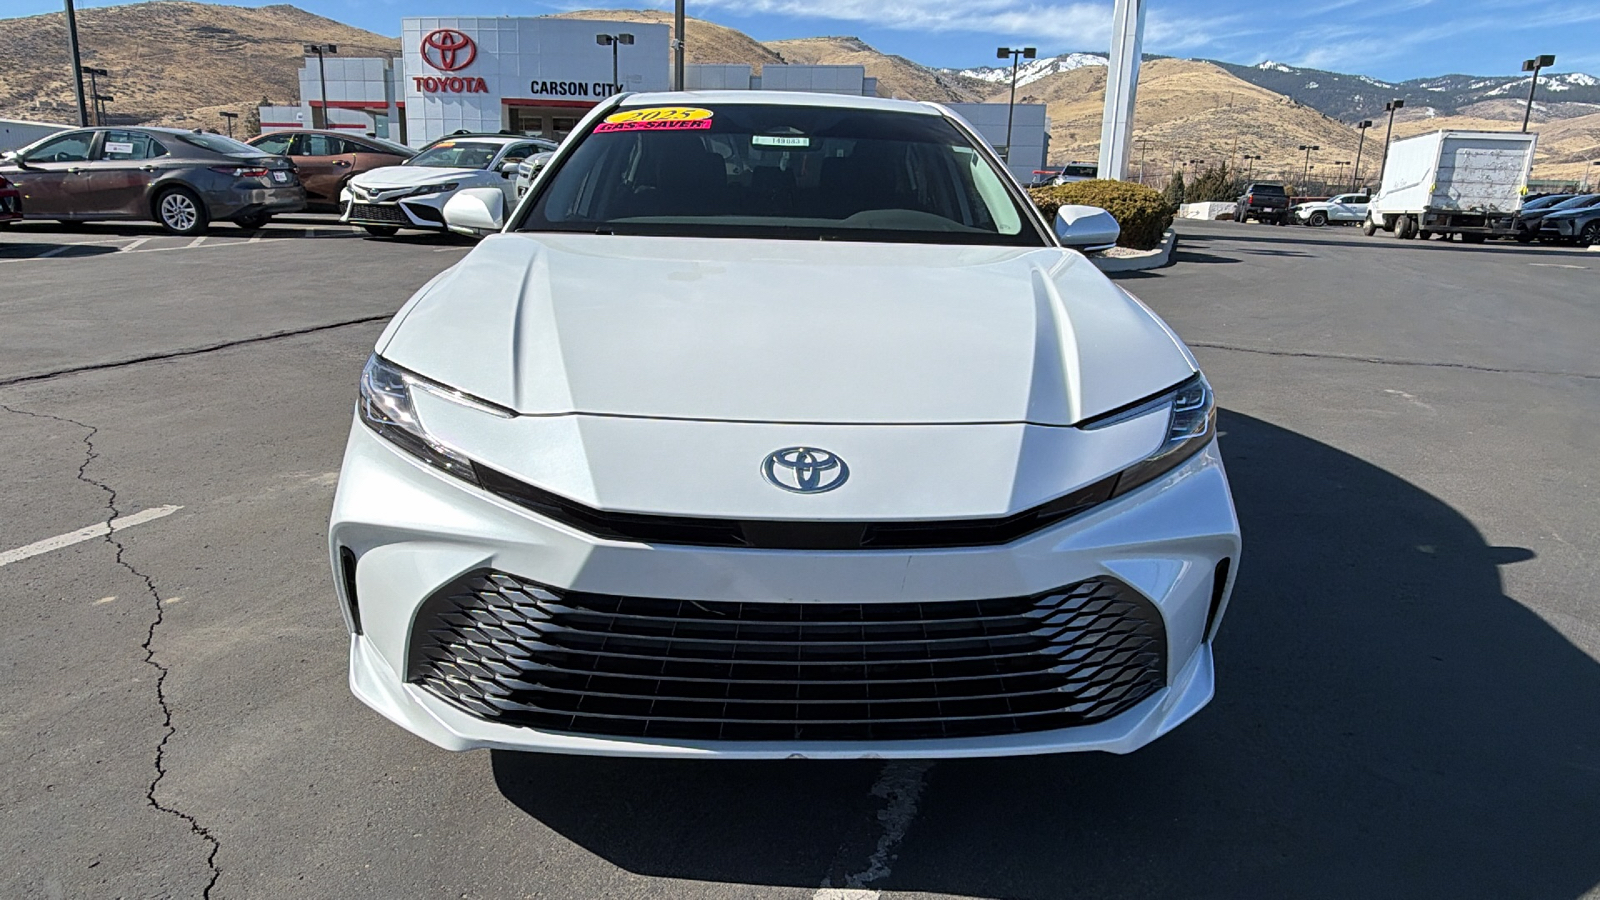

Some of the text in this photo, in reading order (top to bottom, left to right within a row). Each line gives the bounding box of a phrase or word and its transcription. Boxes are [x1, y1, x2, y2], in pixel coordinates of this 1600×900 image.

[412, 77, 488, 93] TOYOTA
[531, 81, 588, 96] CARSON
[622, 110, 696, 122] 2025
